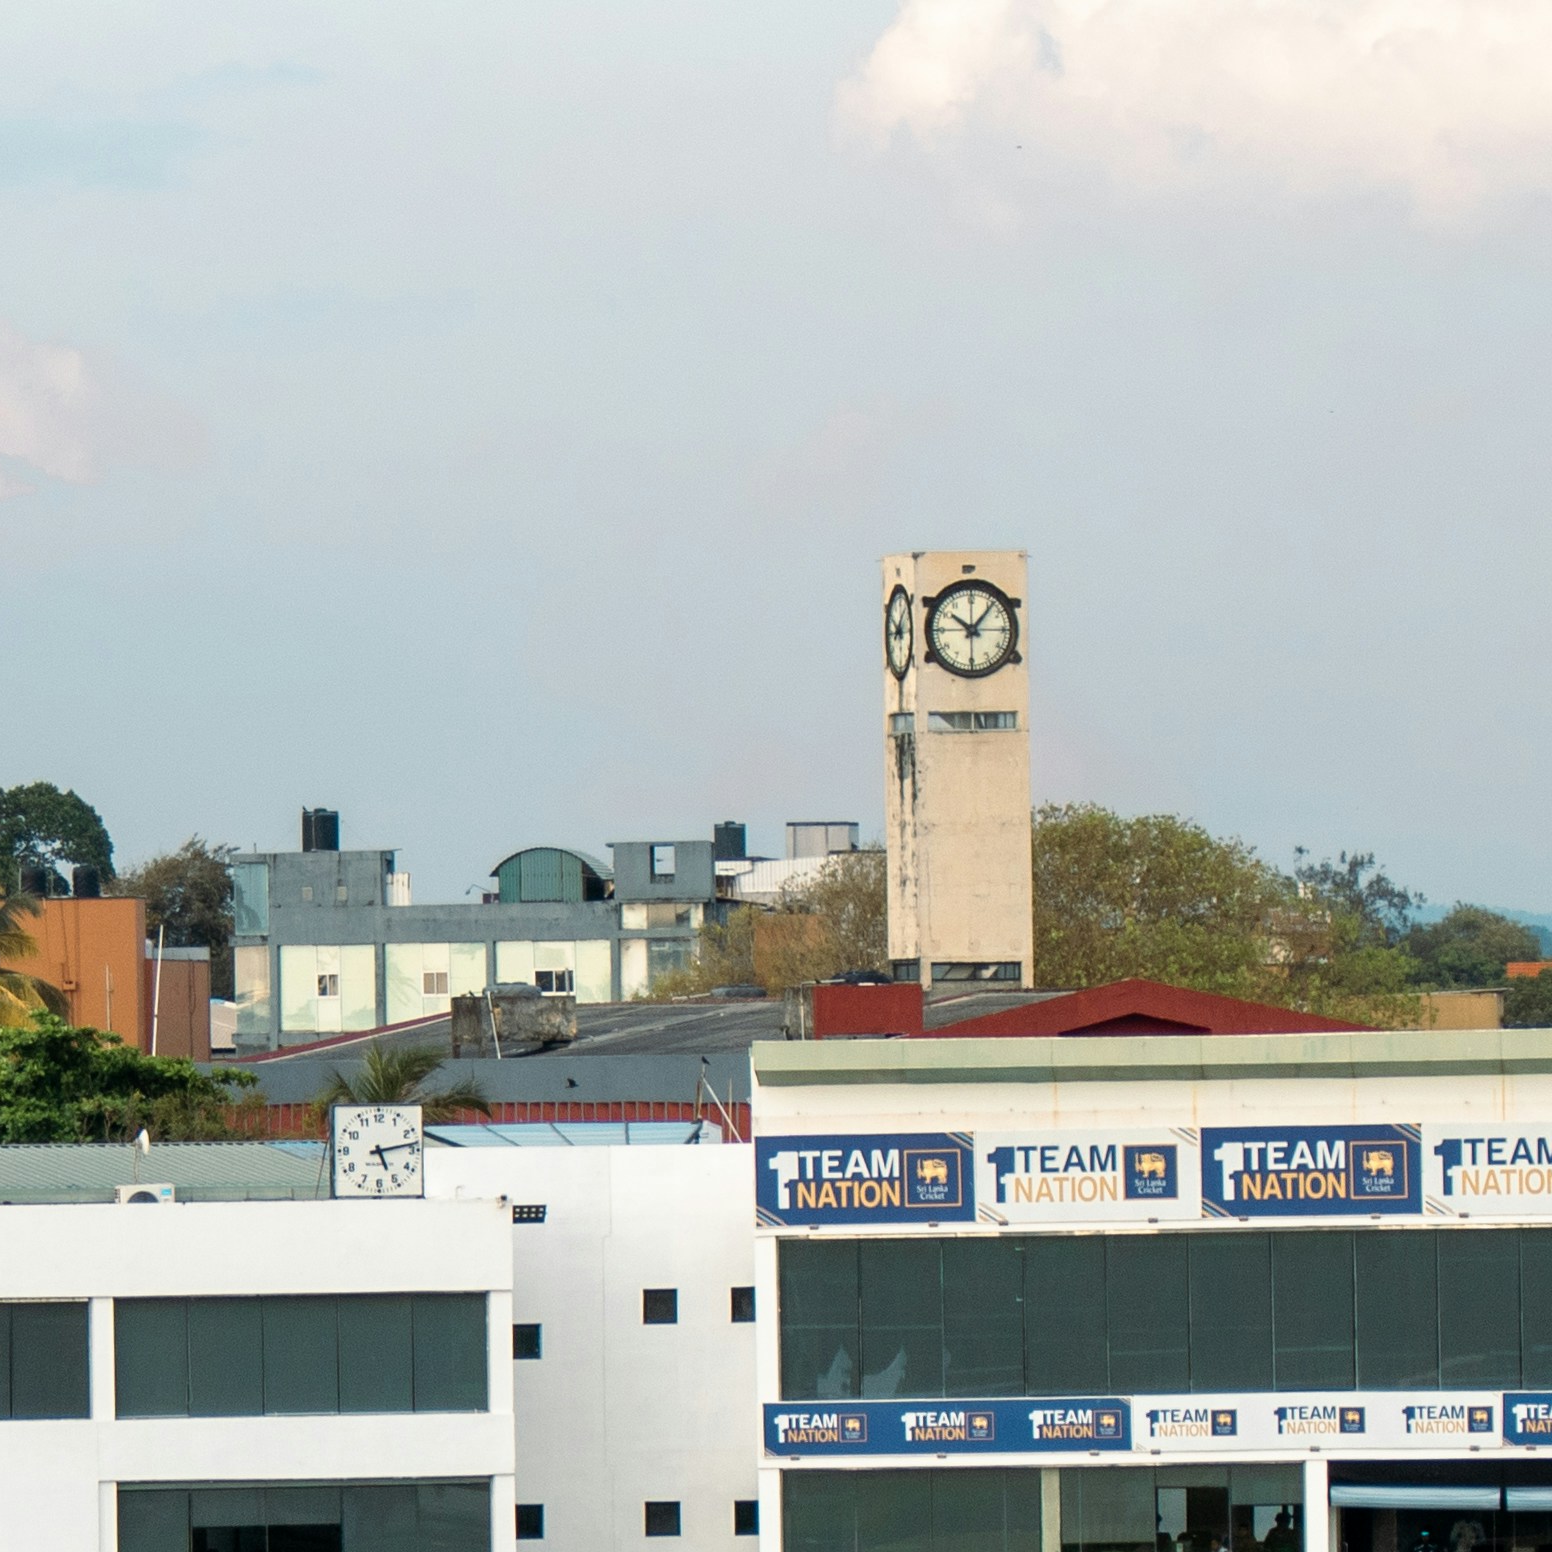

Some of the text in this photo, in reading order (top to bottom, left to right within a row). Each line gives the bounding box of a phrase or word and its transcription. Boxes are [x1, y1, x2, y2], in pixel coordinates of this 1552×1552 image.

[360, 1118, 369, 1127] 11
[374, 1114, 384, 1123] 12
[392, 1118, 396, 1127] 1
[348, 1131, 359, 1140] 10
[403, 1130, 410, 1139] 2
[343, 1146, 349, 1155] 9
[408, 1146, 415, 1155] 3
[348, 1162, 355, 1172] 8
[404, 1162, 410, 1170] 4
[361, 1174, 367, 1183] 7
[391, 1174, 398, 1183] 5
[1134, 1178, 1167, 1188] Sri Lanka
[1362, 1176, 1395, 1186] Sri Lanka
[376, 1179, 382, 1188] 6
[1241, 1171, 1347, 1200] NATION
[916, 1185, 949, 1194] Sri Lanka
[1013, 1175, 1118, 1204] NATION
[1137, 1186, 1163, 1194] Cricket
[1365, 1185, 1392, 1193] Cricket
[796, 1180, 901, 1209] NATION
[1043, 1424, 1093, 1438] NATION
[1159, 1423, 1208, 1437] NATION
[1287, 1421, 1336, 1434] NATION
[1415, 1420, 1465, 1433] NATION
[788, 1428, 838, 1442] NATION
[916, 1426, 965, 1441] NATION
